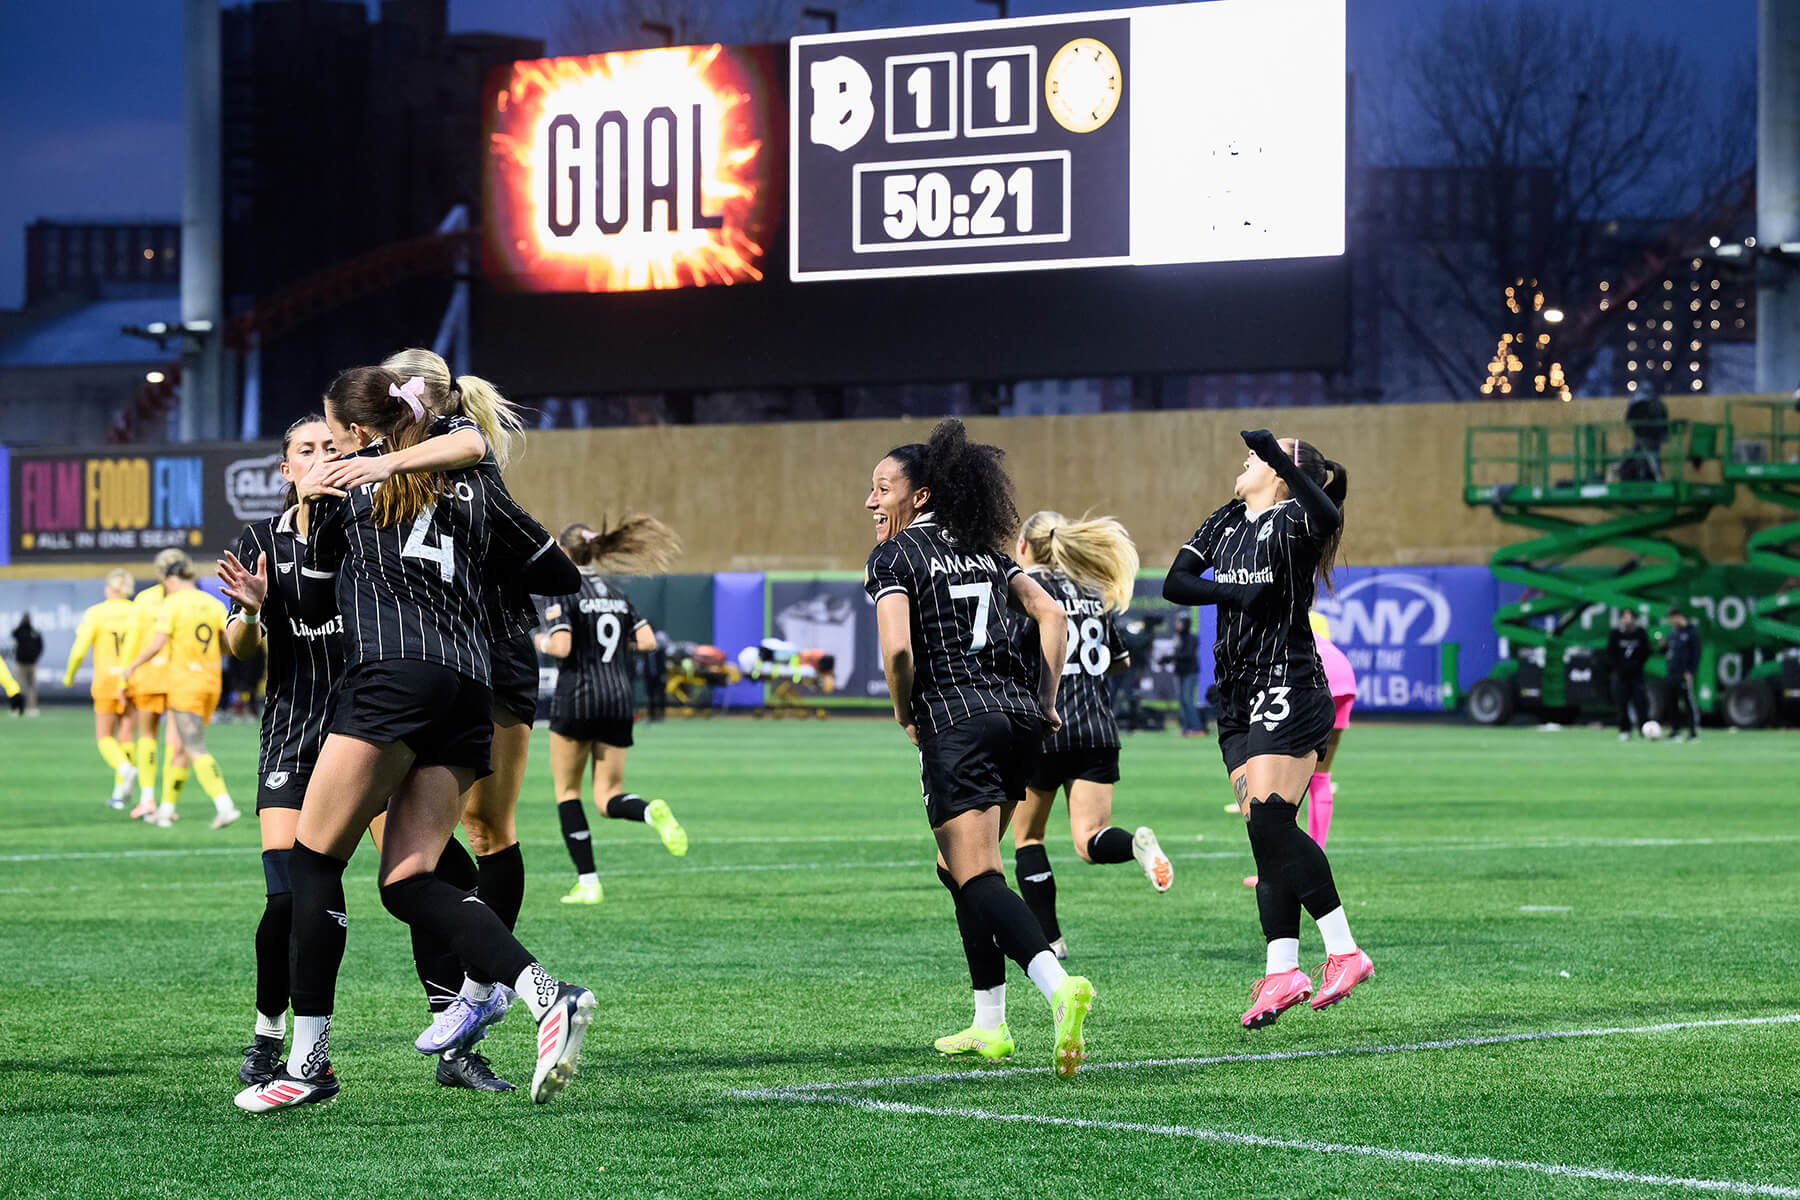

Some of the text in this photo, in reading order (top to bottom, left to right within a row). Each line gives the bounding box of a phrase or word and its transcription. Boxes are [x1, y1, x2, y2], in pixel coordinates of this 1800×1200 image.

[907, 66, 932, 129] 1
[986, 60, 1011, 123] 1
[548, 103, 723, 237] GOAL
[883, 167, 1033, 240] 50:21
[22, 457, 203, 530] FILM FOOD FUN
[37, 530, 187, 549] ALL IN ONE SEAT
[401, 501, 455, 583] 4
[194, 622, 213, 654] 9
[596, 613, 621, 663] 9
[948, 581, 992, 655] 7
[1376, 650, 1404, 670] THE
[1249, 686, 1292, 725] 23
